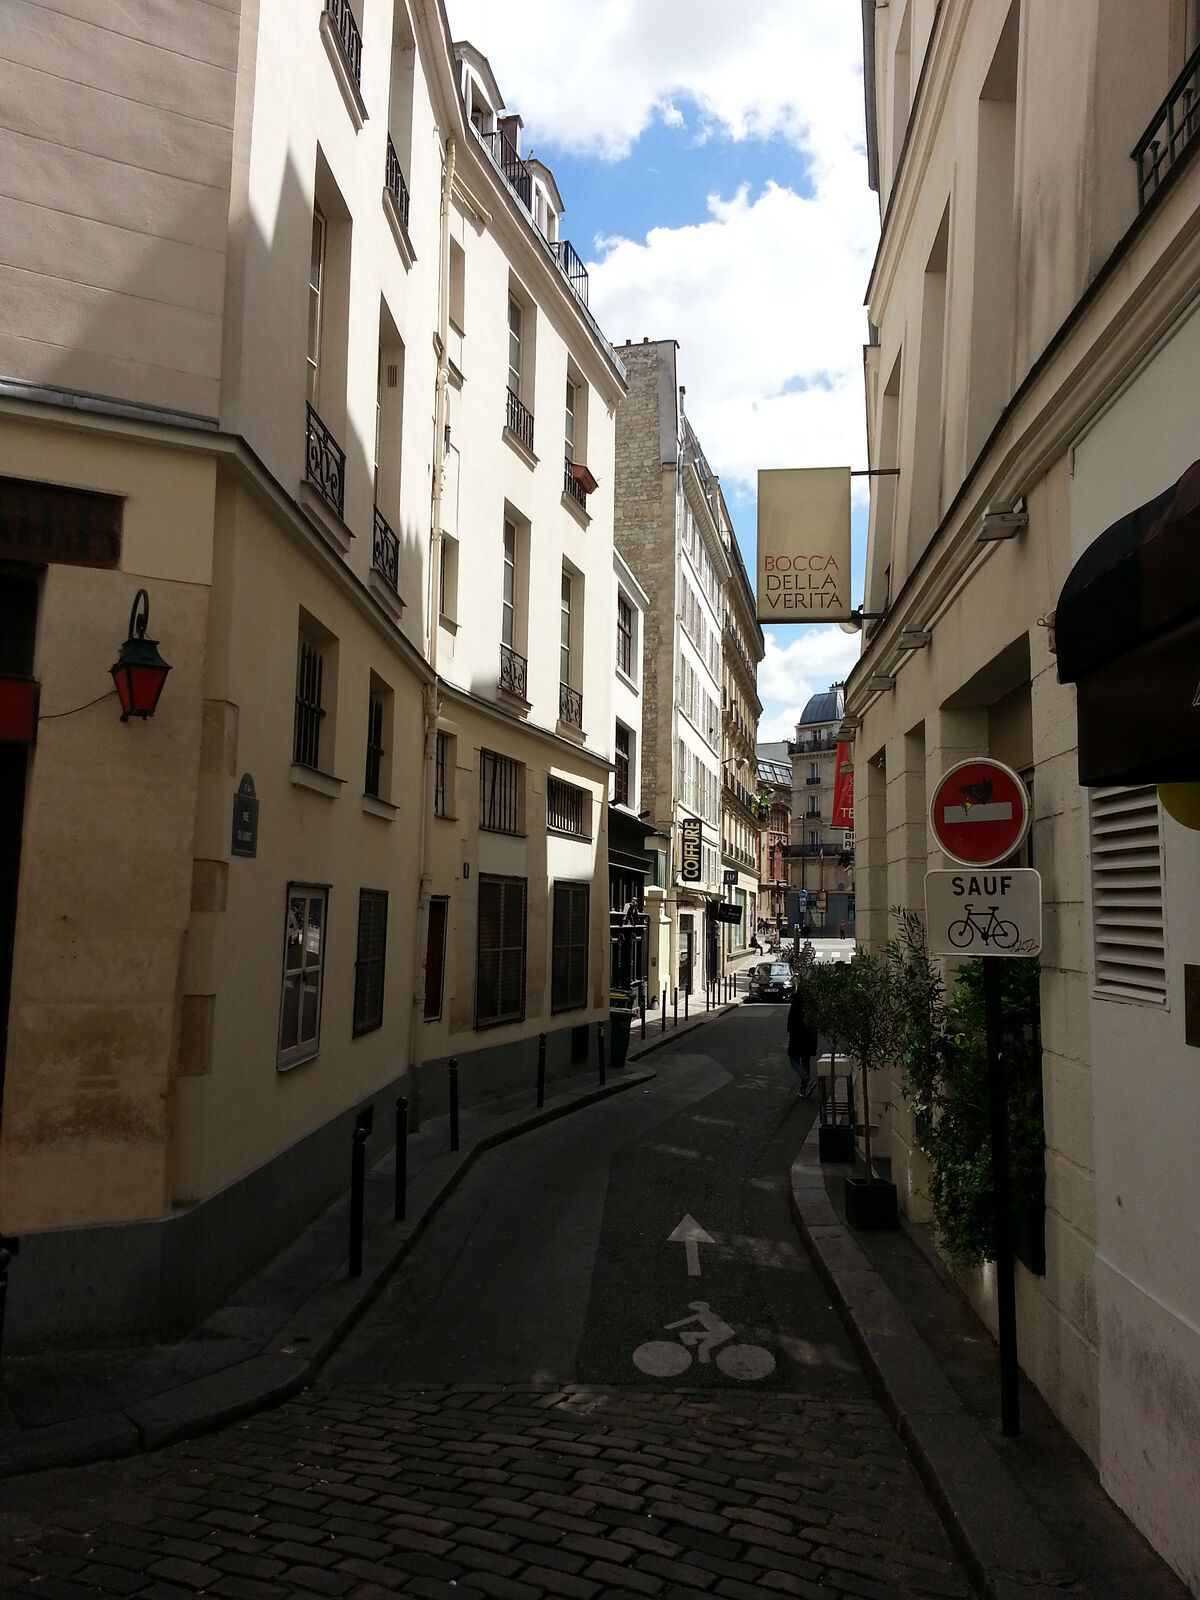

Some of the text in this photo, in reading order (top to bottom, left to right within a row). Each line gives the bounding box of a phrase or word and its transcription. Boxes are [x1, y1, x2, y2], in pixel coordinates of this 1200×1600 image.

[764, 555, 839, 572] BOCCA
[766, 574, 837, 591] DELLA
[765, 592, 843, 609] VERITA
[683, 822, 700, 878] COIFFURE
[952, 875, 1012, 896] SAUF
